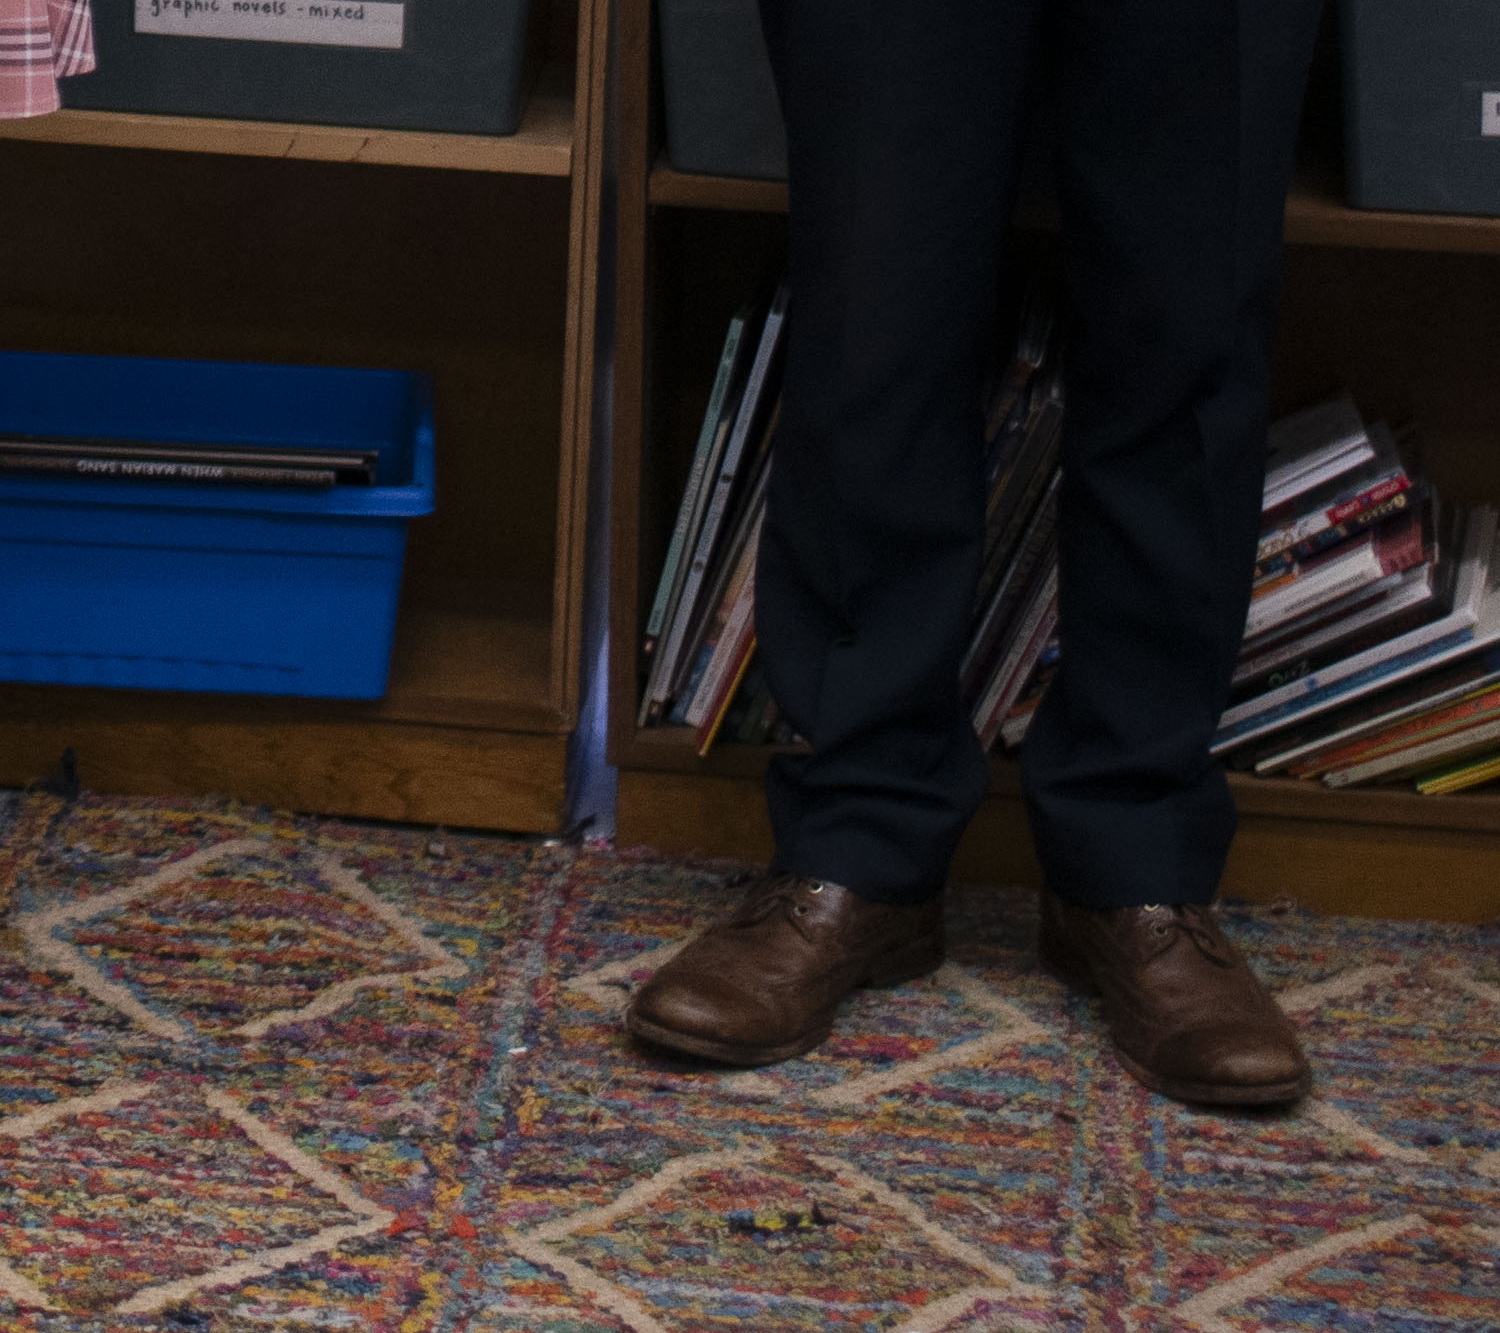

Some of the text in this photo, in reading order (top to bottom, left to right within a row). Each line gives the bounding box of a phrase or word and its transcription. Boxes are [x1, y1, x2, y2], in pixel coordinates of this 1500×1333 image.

[233, 1, 287, 15] novels
[76, 460, 117, 473] SANG
[121, 463, 176, 475] MARIAN
[181, 466, 223, 477] WHEN
